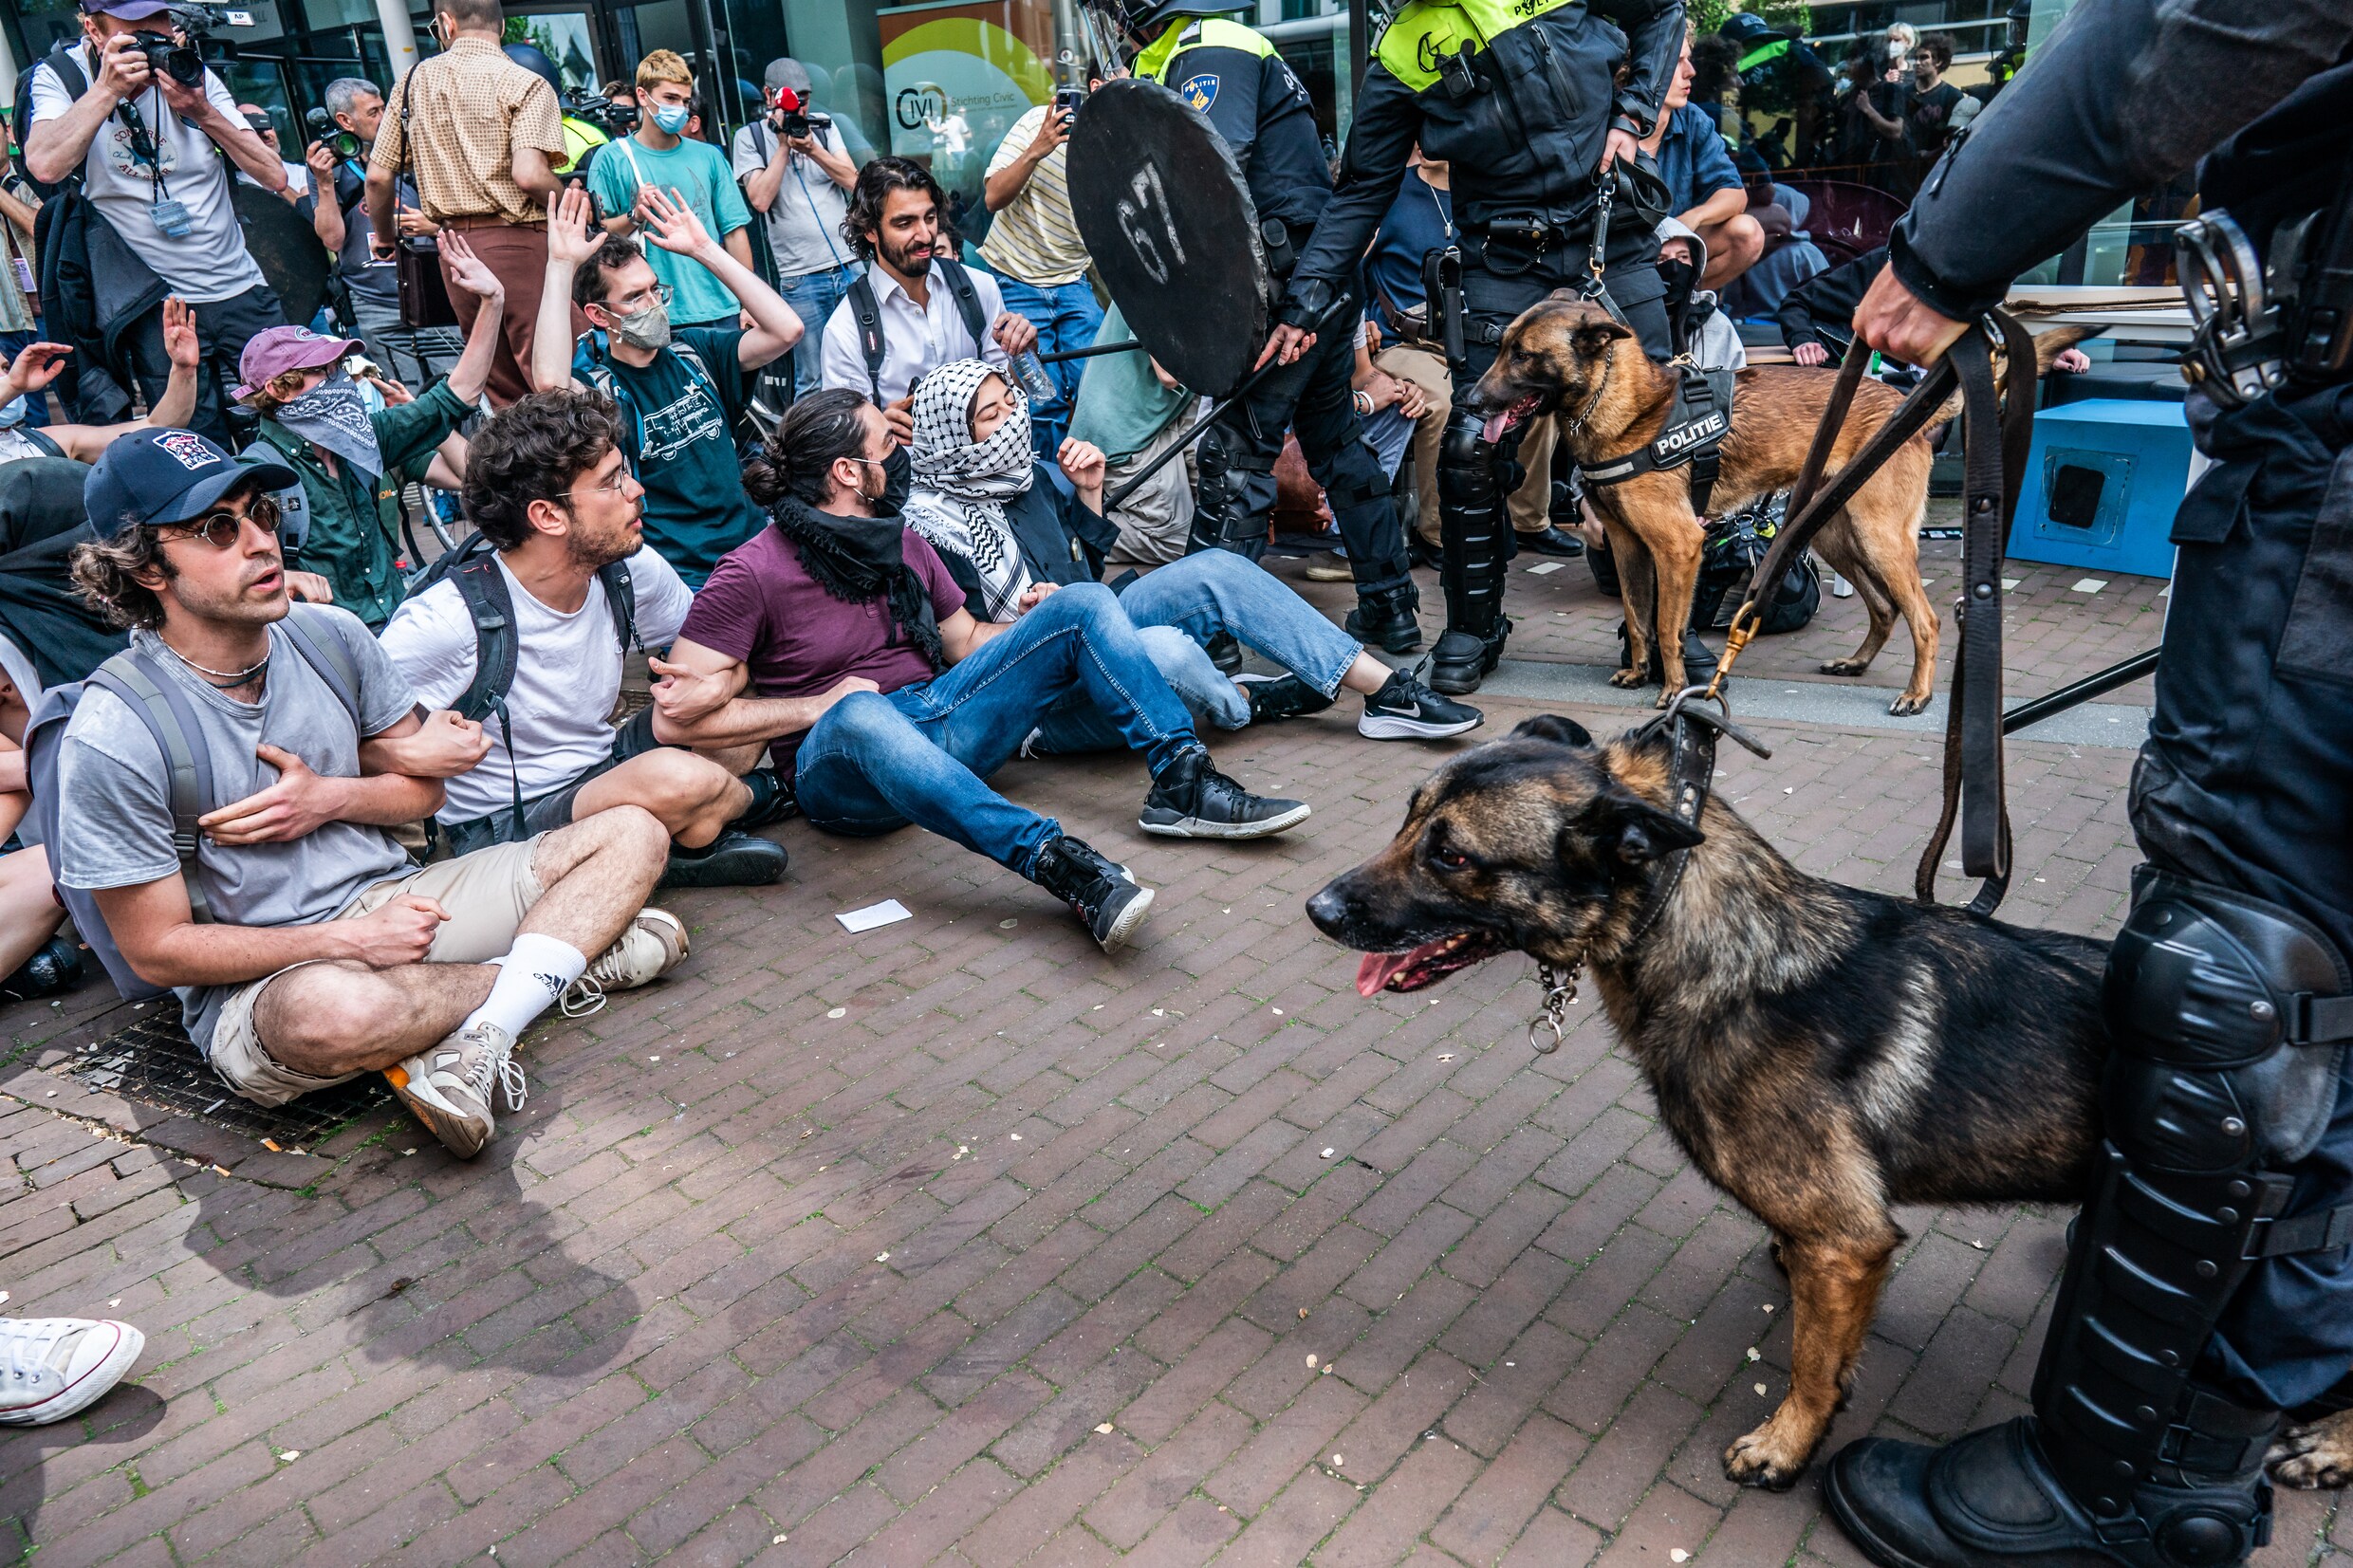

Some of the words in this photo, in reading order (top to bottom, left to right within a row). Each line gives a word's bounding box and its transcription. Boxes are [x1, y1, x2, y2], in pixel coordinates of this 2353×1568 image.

[1184, 79, 1216, 93] POLITIE
[951, 94, 991, 107] Stichting
[992, 92, 1015, 103] Civic
[119, 164, 139, 178] ALL
[1118, 161, 1187, 285] 67
[1656, 414, 1724, 456] POLITIE
